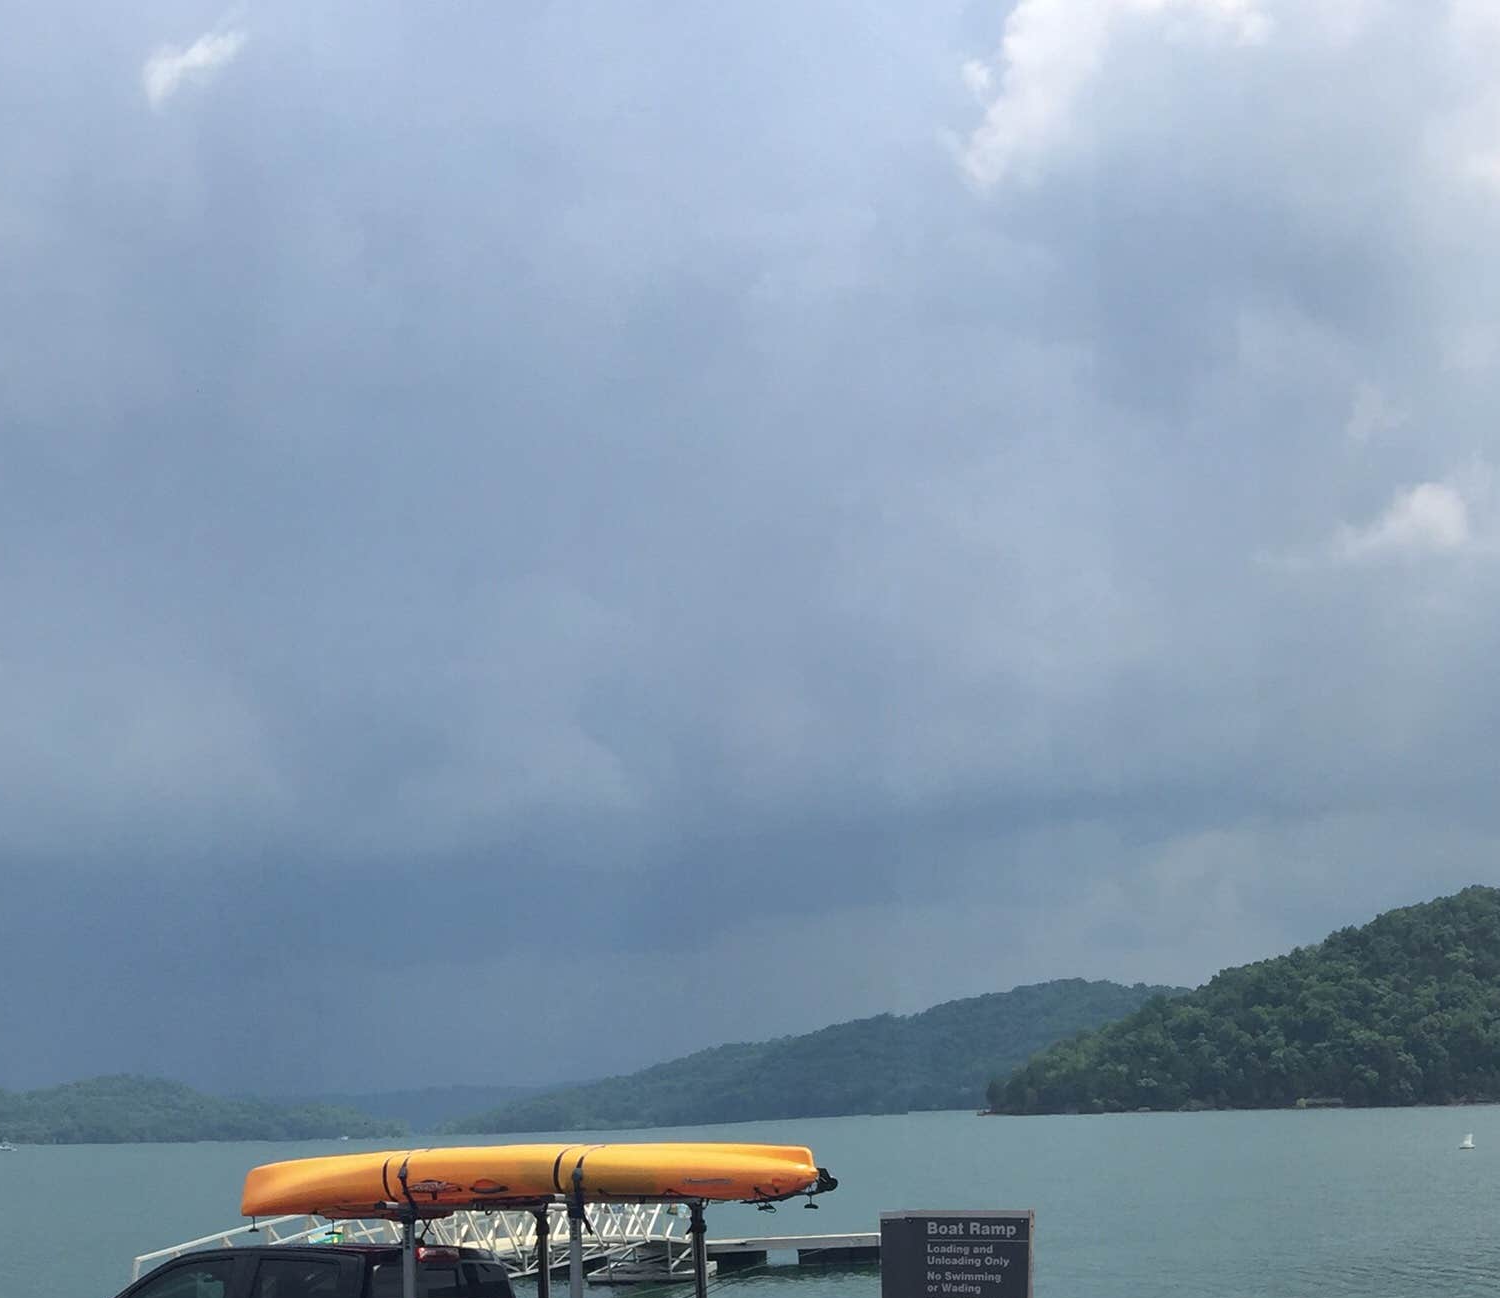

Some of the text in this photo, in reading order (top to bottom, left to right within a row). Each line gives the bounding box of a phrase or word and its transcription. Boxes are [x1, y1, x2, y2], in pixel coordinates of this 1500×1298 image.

[927, 1222, 1017, 1238] Boat Ramp
[927, 1244, 994, 1255] Loading and
[927, 1256, 1010, 1267] Unloading Only
[927, 1271, 1002, 1283] No Swimming
[927, 1283, 981, 1294] or Wading
